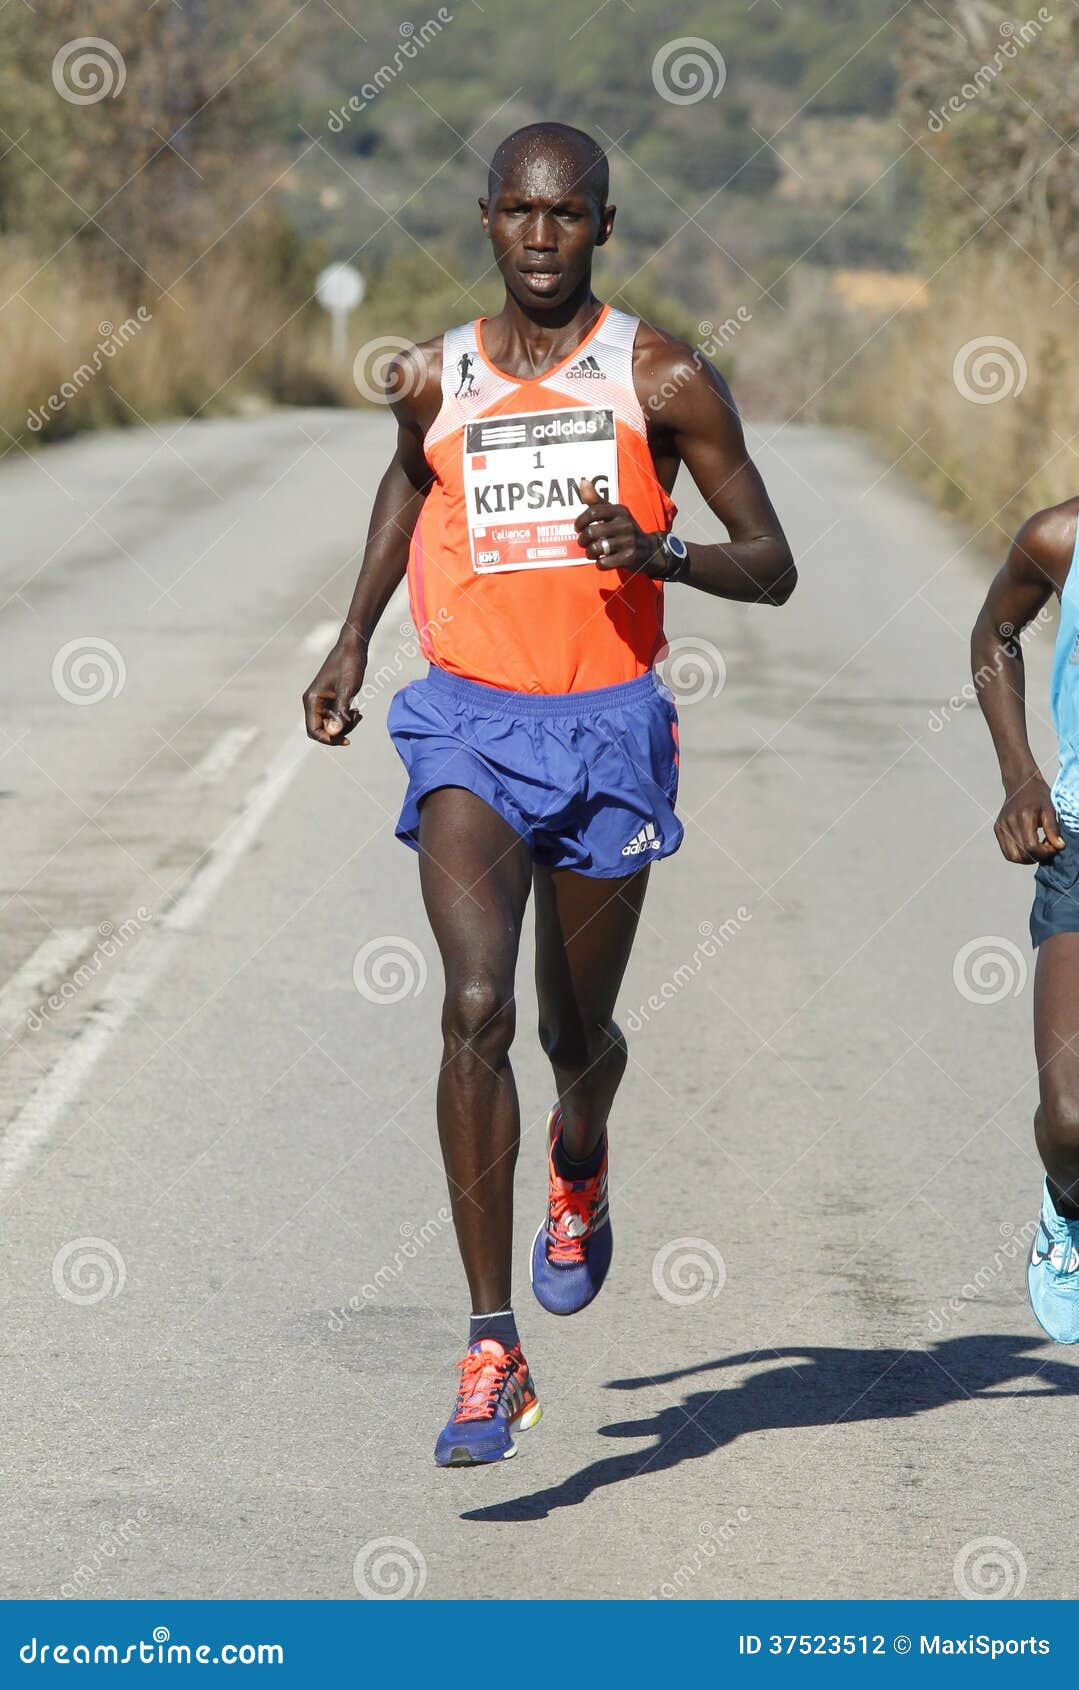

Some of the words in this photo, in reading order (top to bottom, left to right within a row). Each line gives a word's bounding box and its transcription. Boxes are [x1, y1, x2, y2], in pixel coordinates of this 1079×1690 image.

[565, 370, 607, 380] adidas
[533, 419, 597, 438] adidas
[532, 451, 545, 469] 1
[474, 475, 610, 515] KIPSANG
